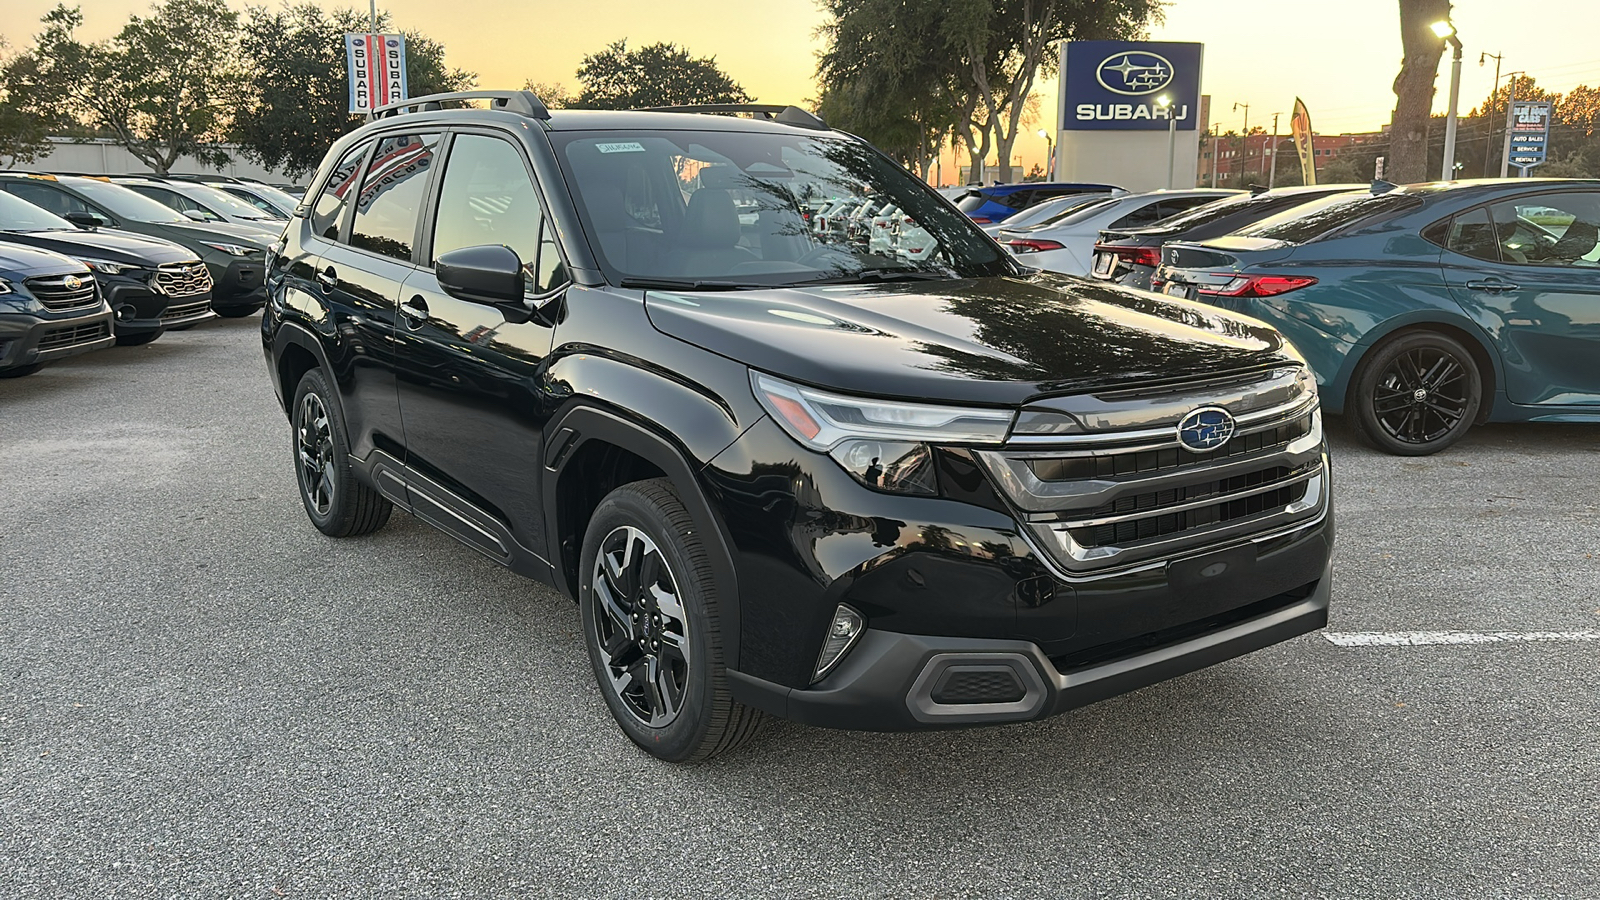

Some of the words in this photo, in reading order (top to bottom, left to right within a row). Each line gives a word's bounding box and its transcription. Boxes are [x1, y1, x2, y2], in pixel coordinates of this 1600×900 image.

[354, 49, 368, 109] SUBARU
[388, 50, 401, 104] SUBAR
[1076, 104, 1188, 120] SUBARU
